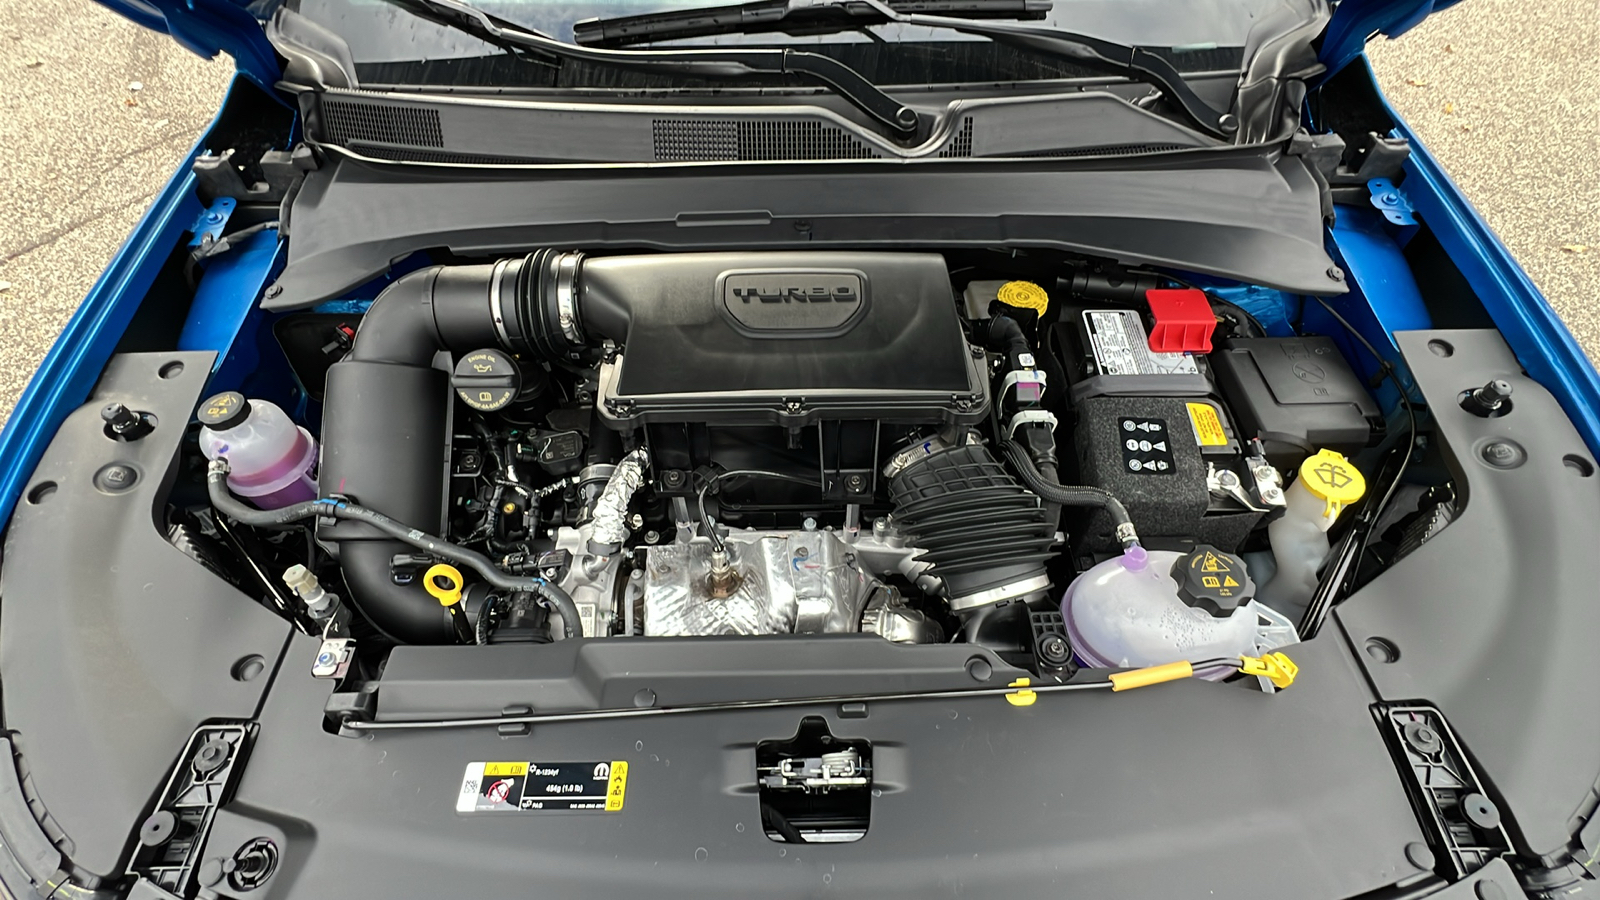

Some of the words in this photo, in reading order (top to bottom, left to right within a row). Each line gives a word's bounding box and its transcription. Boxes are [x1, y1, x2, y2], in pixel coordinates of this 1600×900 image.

[733, 287, 857, 303] TURBO
[467, 354, 487, 363] ENGINE
[487, 355, 496, 363] OIL
